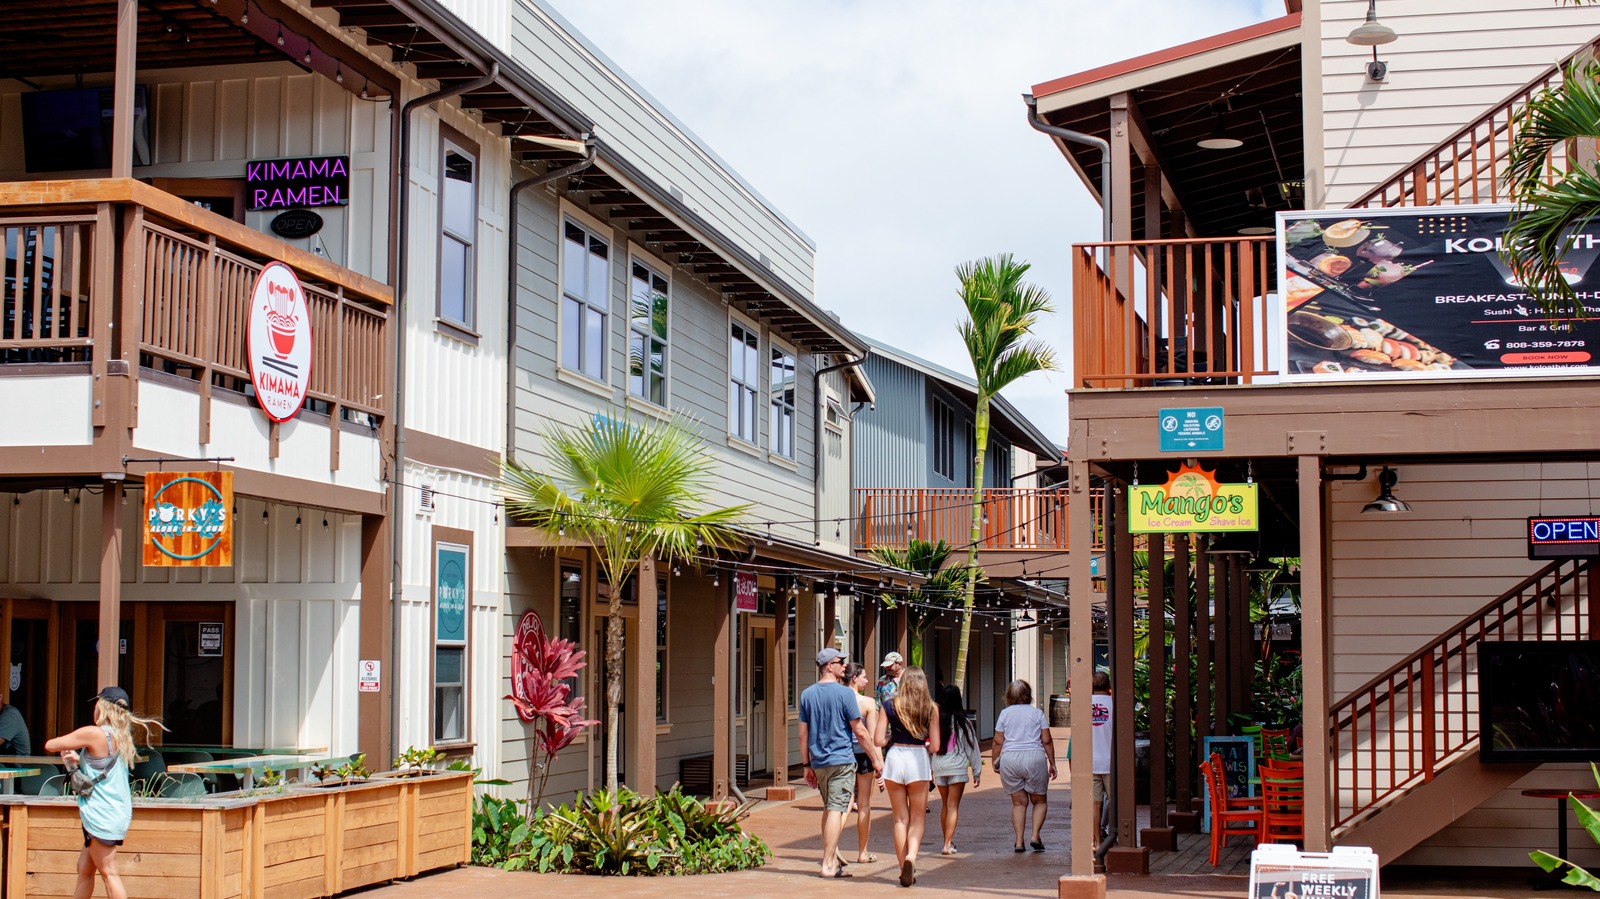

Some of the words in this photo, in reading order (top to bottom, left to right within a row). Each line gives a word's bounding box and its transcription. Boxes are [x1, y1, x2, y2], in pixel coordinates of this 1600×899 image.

[247, 158, 347, 182] KIMAMA
[254, 185, 339, 208] RAMEN
[276, 219, 317, 230] OPEN
[1483, 308, 1513, 316] Sushi
[1505, 340, 1586, 349] 808-359-7878
[259, 371, 300, 399] KIMAMA
[267, 395, 292, 410] RAMEN
[1140, 490, 1244, 523] Mango's
[1147, 517, 1161, 527] Ice
[1163, 517, 1192, 527] Cream
[1209, 516, 1236, 526] Shave
[1238, 516, 1251, 526] Ice
[182, 525, 193, 533] IN
[205, 525, 225, 533] BUN
[1533, 521, 1599, 540] OPEN
[1301, 872, 1336, 884] FREE
[1300, 884, 1358, 897] WEEKLY
